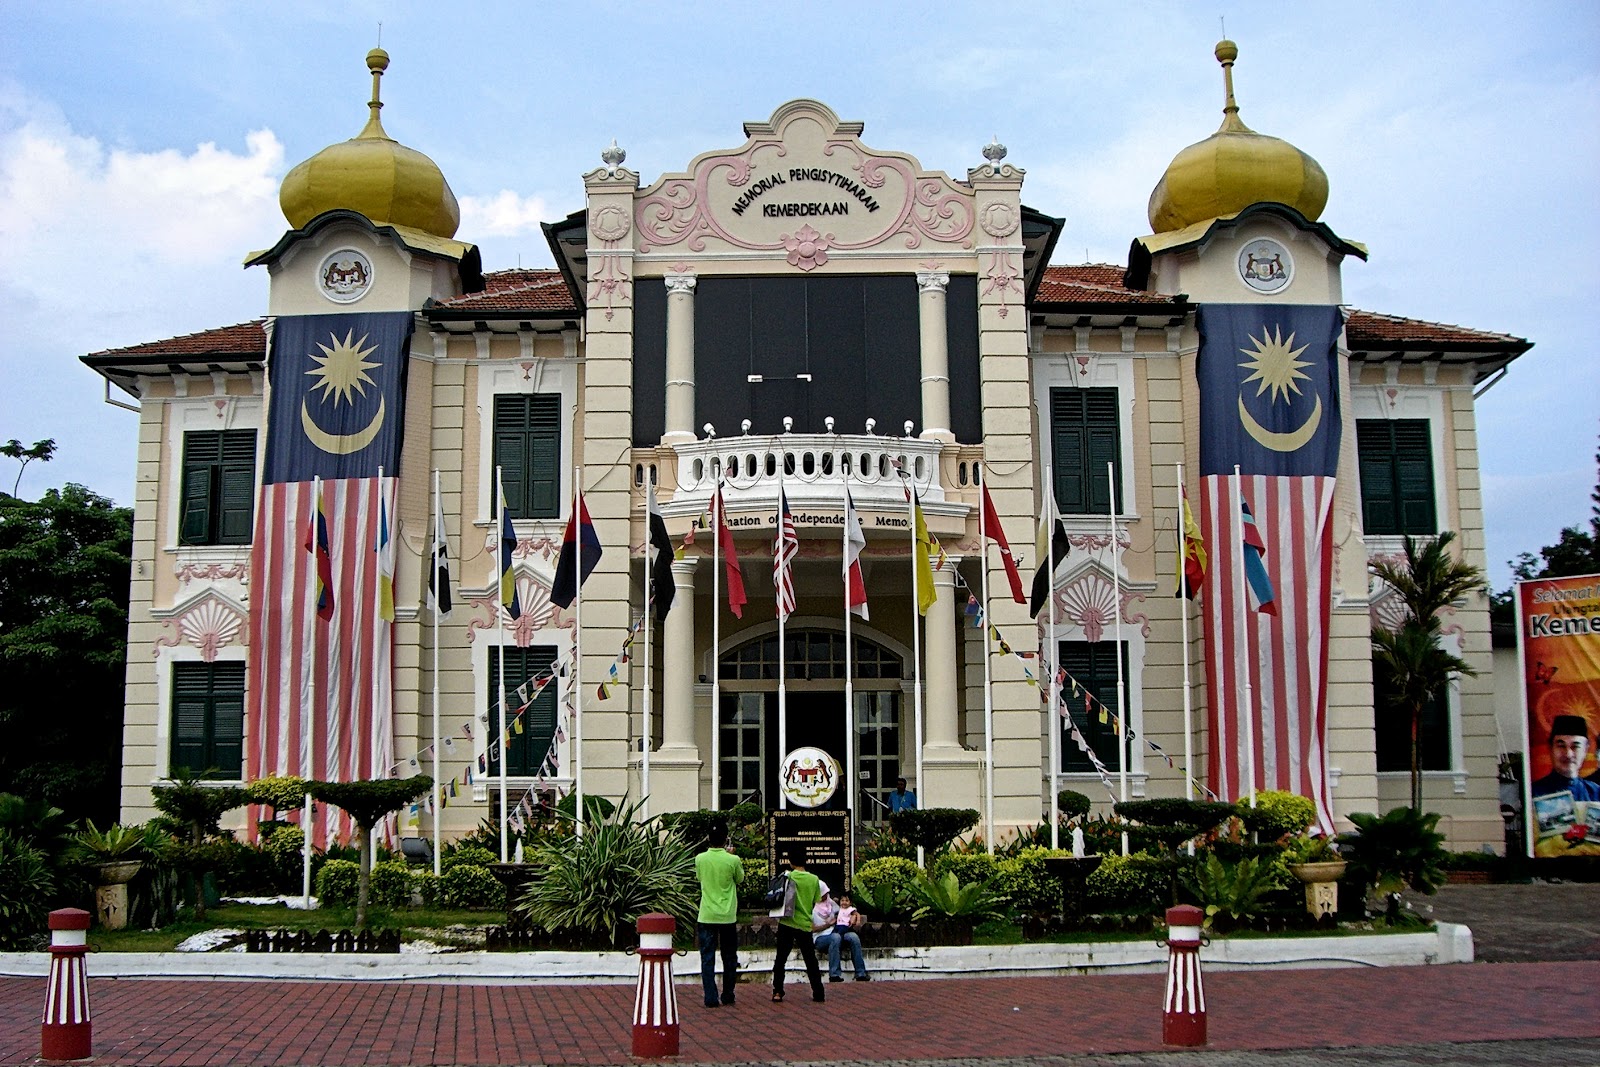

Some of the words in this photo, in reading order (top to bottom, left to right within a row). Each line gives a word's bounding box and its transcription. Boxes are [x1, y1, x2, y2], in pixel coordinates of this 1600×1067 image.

[731, 172, 786, 216] MEMORIAL
[789, 168, 880, 213] PENGISYTIHARAN
[763, 202, 849, 217] KEMERDEKAAN
[1533, 586, 1592, 603] Selamat
[1530, 614, 1600, 638] Keme
